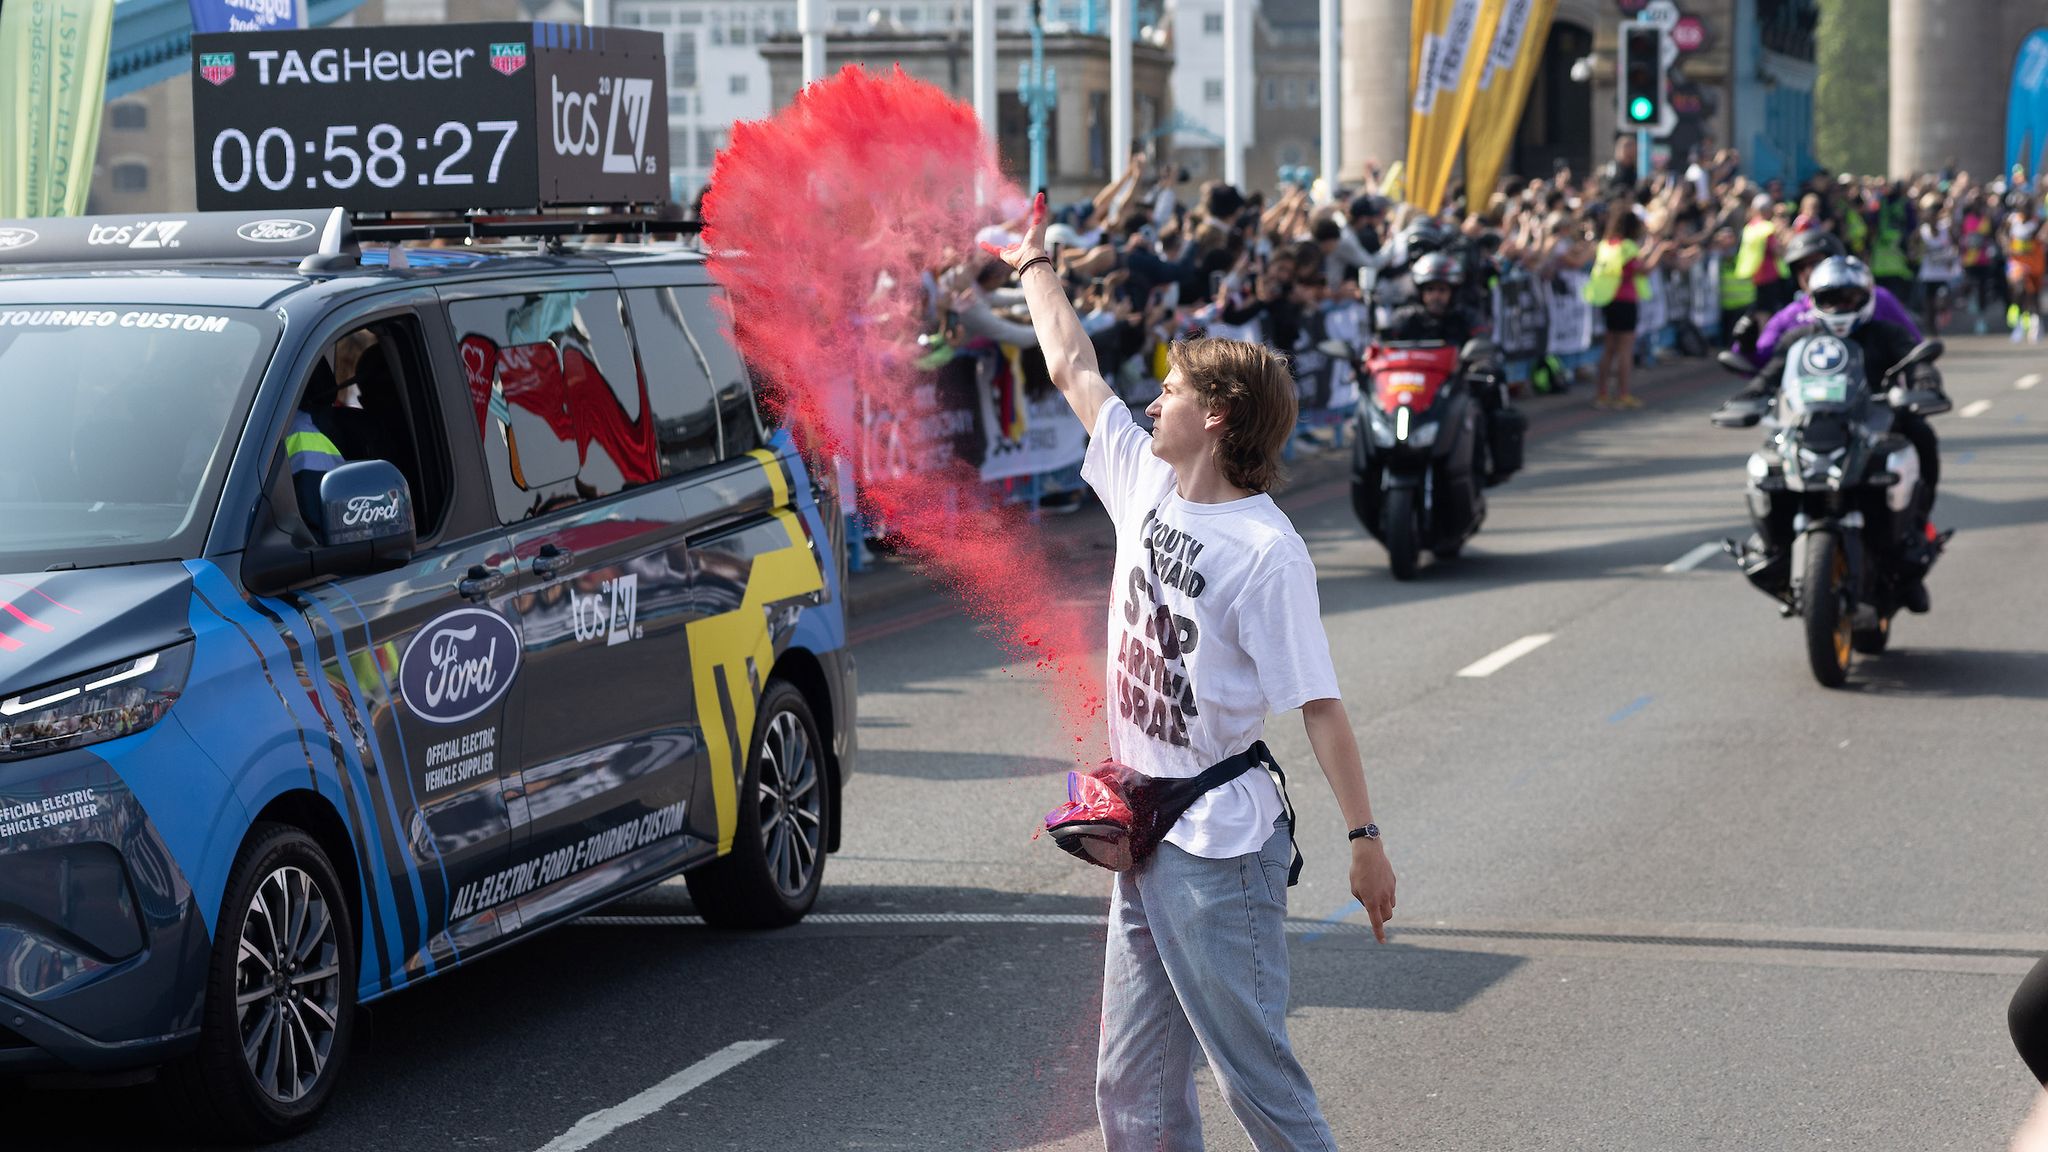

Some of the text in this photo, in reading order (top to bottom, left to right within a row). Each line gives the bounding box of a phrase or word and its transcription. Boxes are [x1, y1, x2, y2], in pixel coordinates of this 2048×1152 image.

[551, 74, 599, 156] tcs
[598, 76, 611, 95] 20
[645, 155, 657, 174] 25
[212, 120, 518, 192] 00:58:27
[87, 224, 133, 245] tcs
[250, 221, 301, 238] Ford
[0, 310, 229, 333] TOURNEO CUSTOM
[342, 494, 399, 525] Ford
[1152, 549, 1206, 598] MAND
[570, 588, 605, 642] tcs
[425, 625, 497, 708] Ford
[426, 726, 495, 767] OFFICIAL ELECTRIC
[425, 751, 494, 792] VEHICLE SUPPLIER
[0, 788, 95, 821] FFICIAL ELECTRIC
[0, 803, 98, 837] EHICLE SUPPLIER
[449, 800, 686, 921] ALL-ELECTRIC FORD E-TOURNEO CUSTOM
